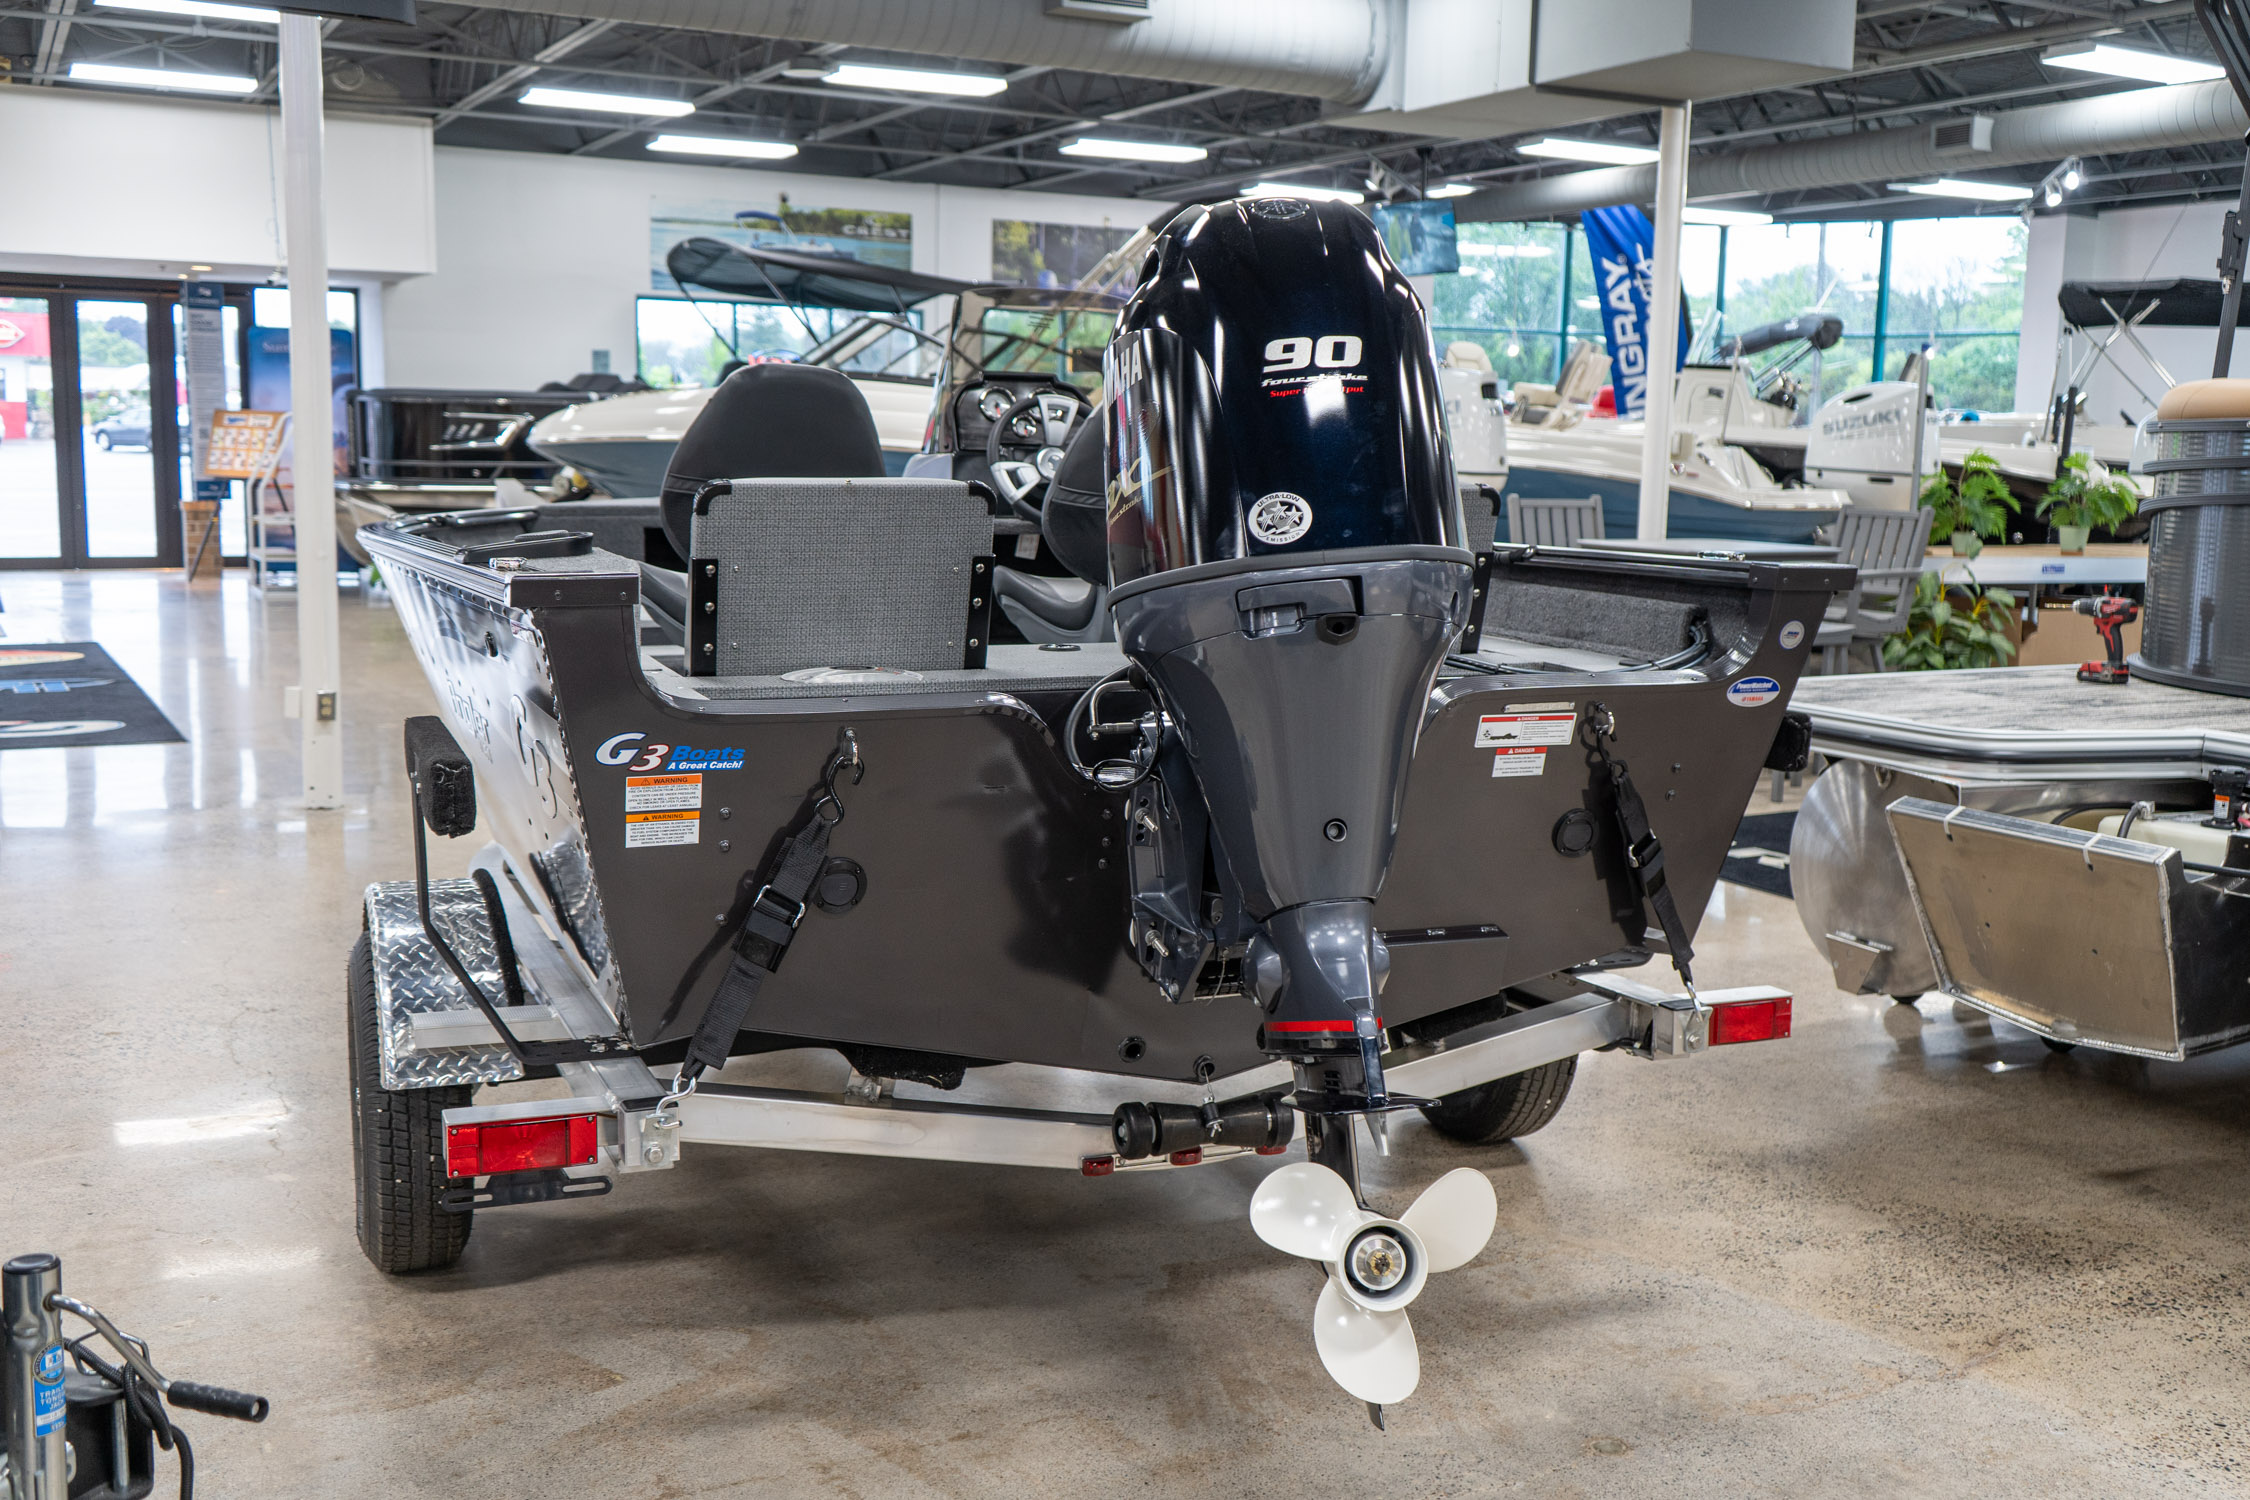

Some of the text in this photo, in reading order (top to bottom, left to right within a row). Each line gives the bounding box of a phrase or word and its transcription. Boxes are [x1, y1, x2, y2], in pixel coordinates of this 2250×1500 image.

[1263, 335, 1363, 374] 90
[1602, 256, 1647, 420] INGRAY
[1104, 339, 1143, 409] MAHA
[1269, 388, 1301, 398] Super
[1823, 408, 1901, 435] SUZUKI
[1266, 531, 1301, 542] EMISSION
[595, 732, 745, 772] G3 Boats
[668, 760, 743, 770] A Great Catch!
